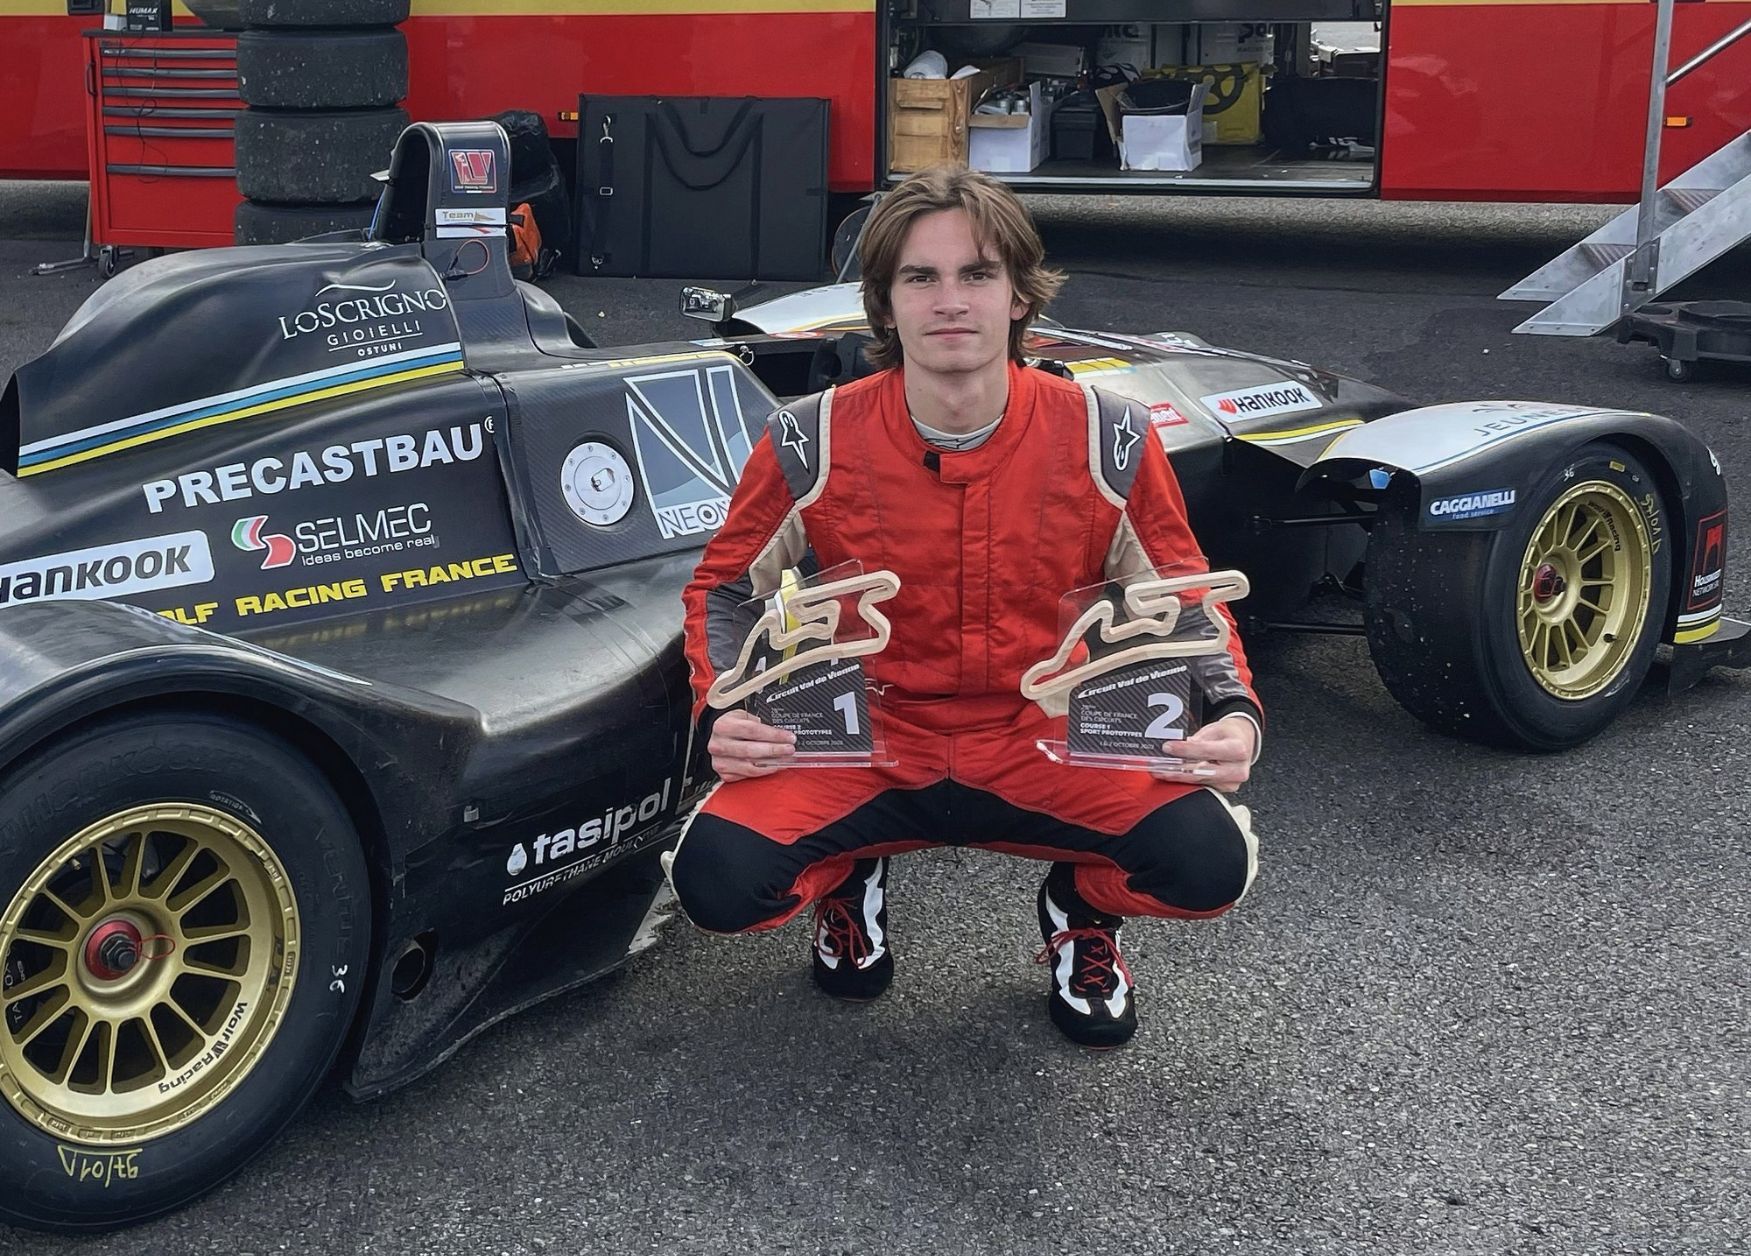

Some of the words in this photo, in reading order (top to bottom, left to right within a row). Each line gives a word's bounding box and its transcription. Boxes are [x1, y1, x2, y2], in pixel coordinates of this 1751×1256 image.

[442, 211, 474, 219] Team
[327, 320, 421, 346] GIOIELLI
[357, 342, 402, 357] OSTUNI
[1430, 489, 1516, 515] CAGGIANELLI
[295, 502, 432, 553] SELMEC
[1607, 518, 1621, 552] Racing
[344, 541, 404, 560] become
[406, 534, 435, 550] real
[156, 602, 219, 626] LF
[235, 579, 368, 617] RACING
[380, 554, 518, 593] FRANCE
[799, 680, 815, 691] Val
[815, 676, 827, 685] de
[1078, 684, 1116, 698] Circuit
[1117, 679, 1134, 689] Val
[1135, 675, 1150, 684] de
[1150, 665, 1187, 679] Vienne
[833, 691, 860, 735] 1
[1144, 692, 1184, 740] 2
[1101, 730, 1143, 738] PROTOTYPES
[533, 778, 672, 864] tasipol
[222, 1002, 248, 1042] Wolf
[158, 1052, 214, 1095] Racing
